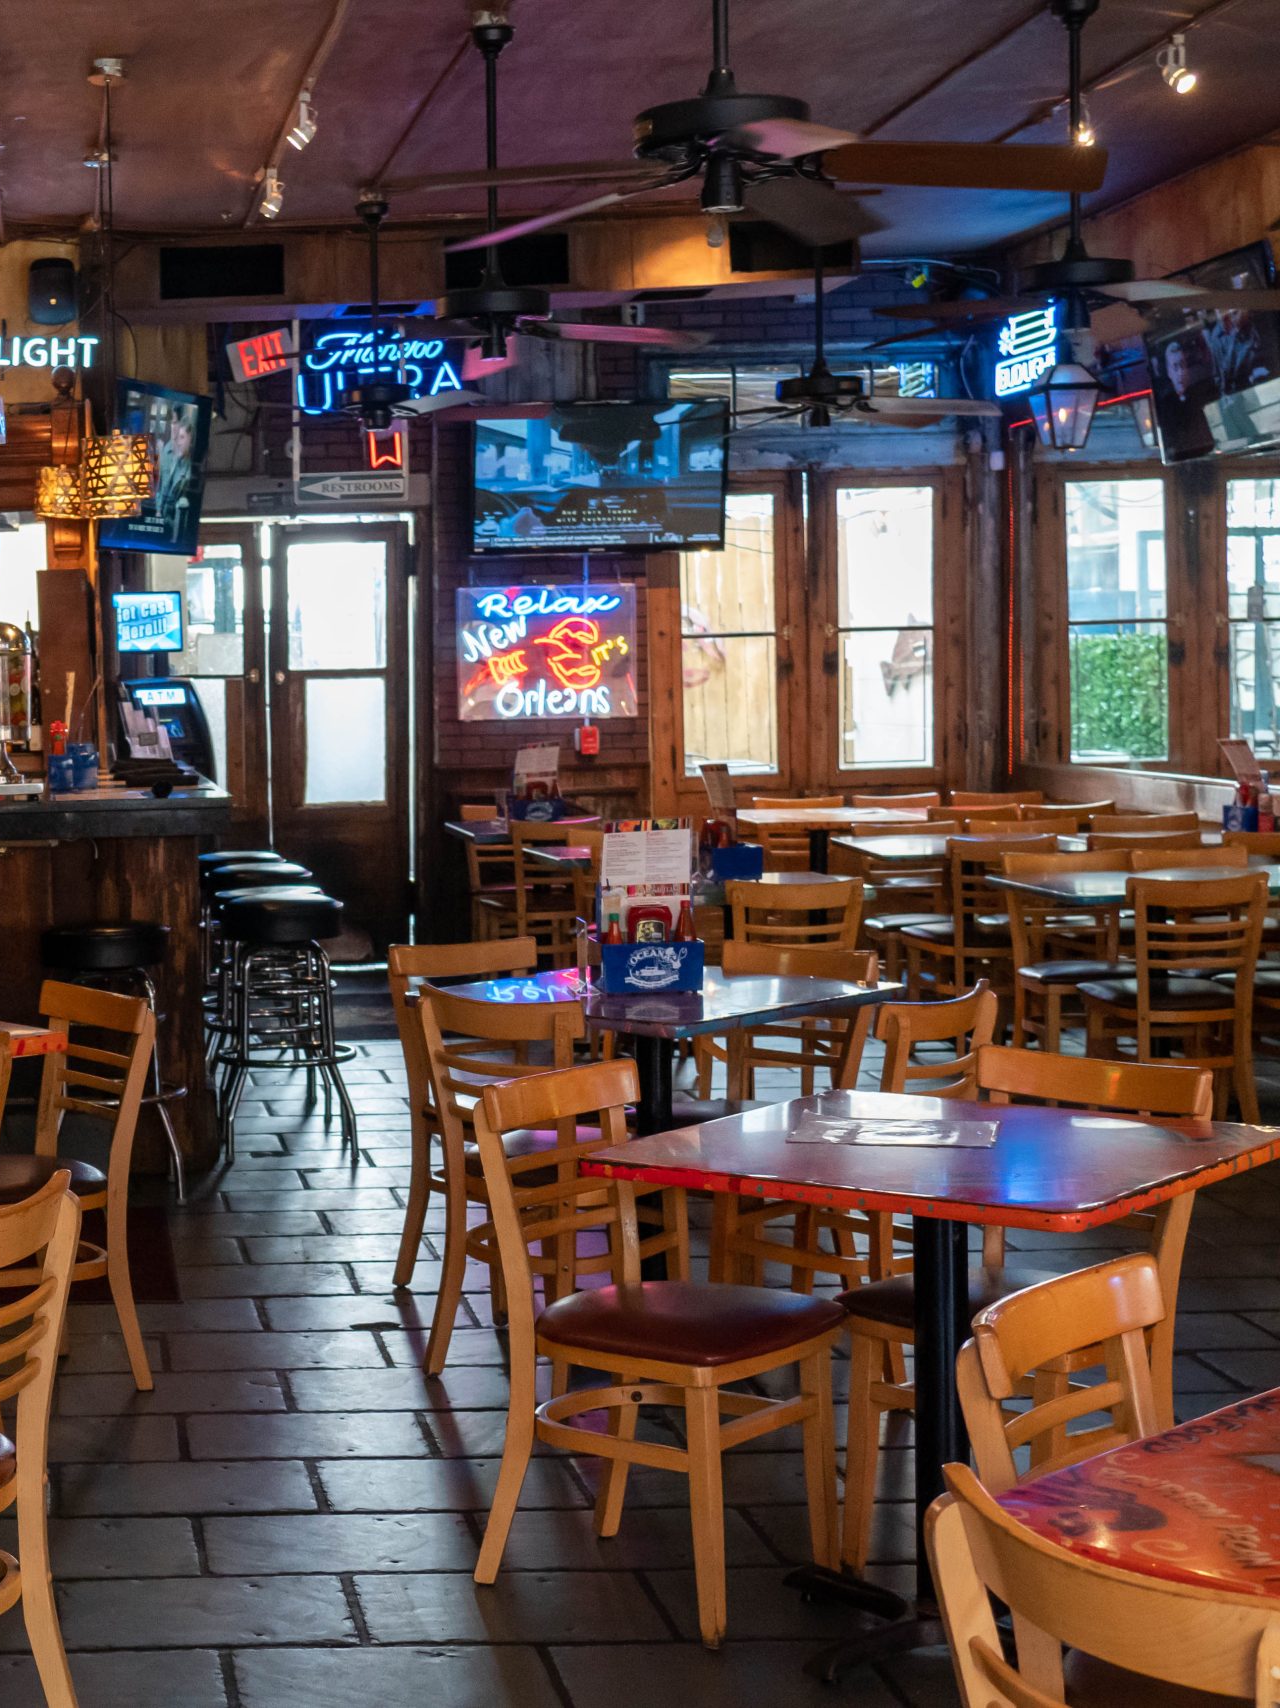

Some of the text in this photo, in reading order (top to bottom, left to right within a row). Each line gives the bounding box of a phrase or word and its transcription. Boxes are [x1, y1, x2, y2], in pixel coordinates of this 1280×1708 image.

[238, 332, 287, 377] EXIT
[321, 481, 401, 493] RESTROOMS
[141, 599, 174, 619] Cash
[477, 590, 620, 618] Relax
[463, 616, 526, 663] New
[591, 635, 629, 666] IT'S
[496, 678, 611, 717] Orleans
